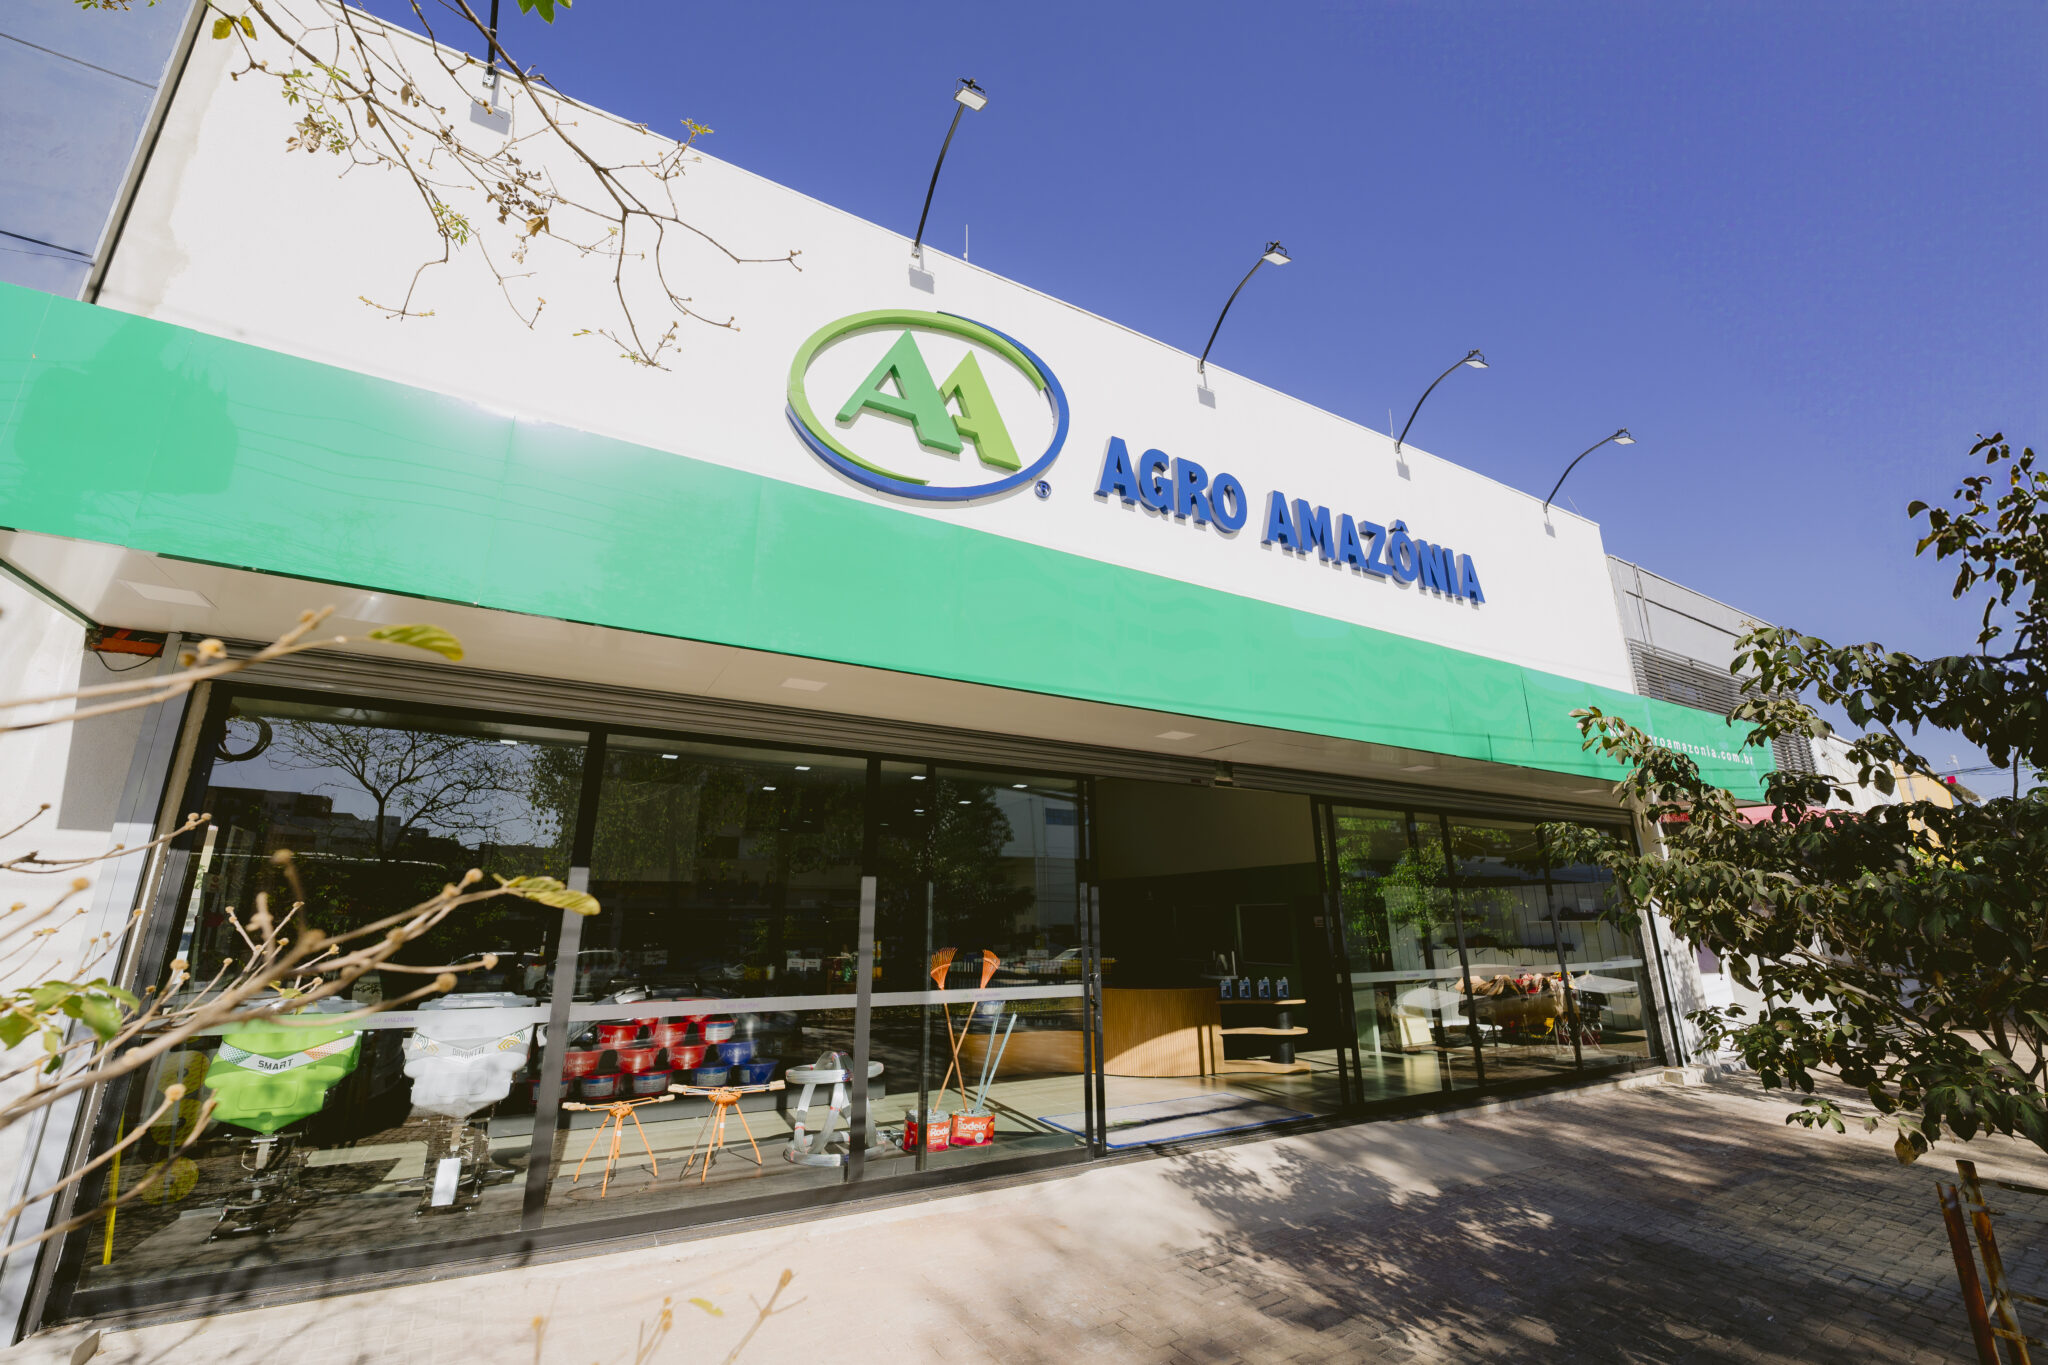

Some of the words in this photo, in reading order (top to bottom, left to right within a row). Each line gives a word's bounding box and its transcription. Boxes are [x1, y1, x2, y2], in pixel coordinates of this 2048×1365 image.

[1096, 435, 1248, 533] AGRO
[1263, 489, 1486, 605] AMAZÔNIA
[257, 1057, 294, 1071] SMART
